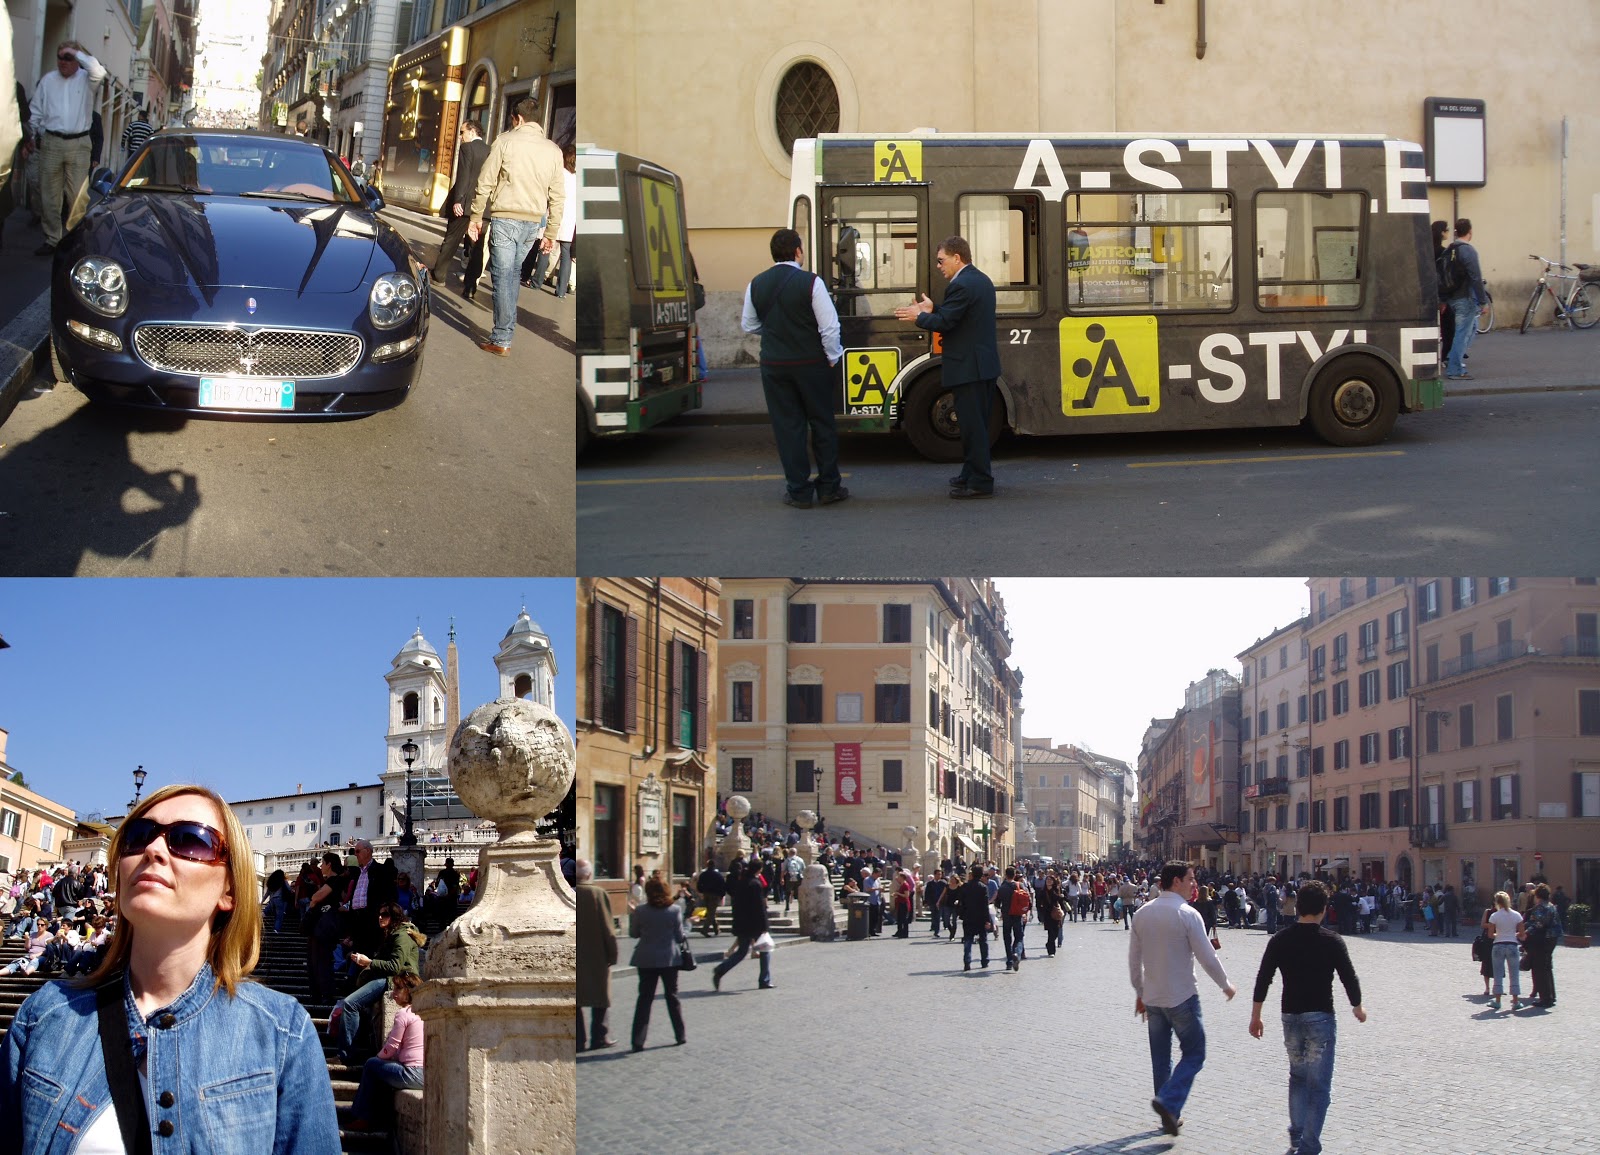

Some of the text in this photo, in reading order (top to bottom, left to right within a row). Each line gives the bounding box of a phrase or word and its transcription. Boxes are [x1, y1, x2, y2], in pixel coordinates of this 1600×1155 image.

[656, 301, 688, 324] A-STYLE
[1009, 329, 1032, 345] 27
[850, 405, 898, 416] A-STYE
[646, 814, 656, 824] TEA
